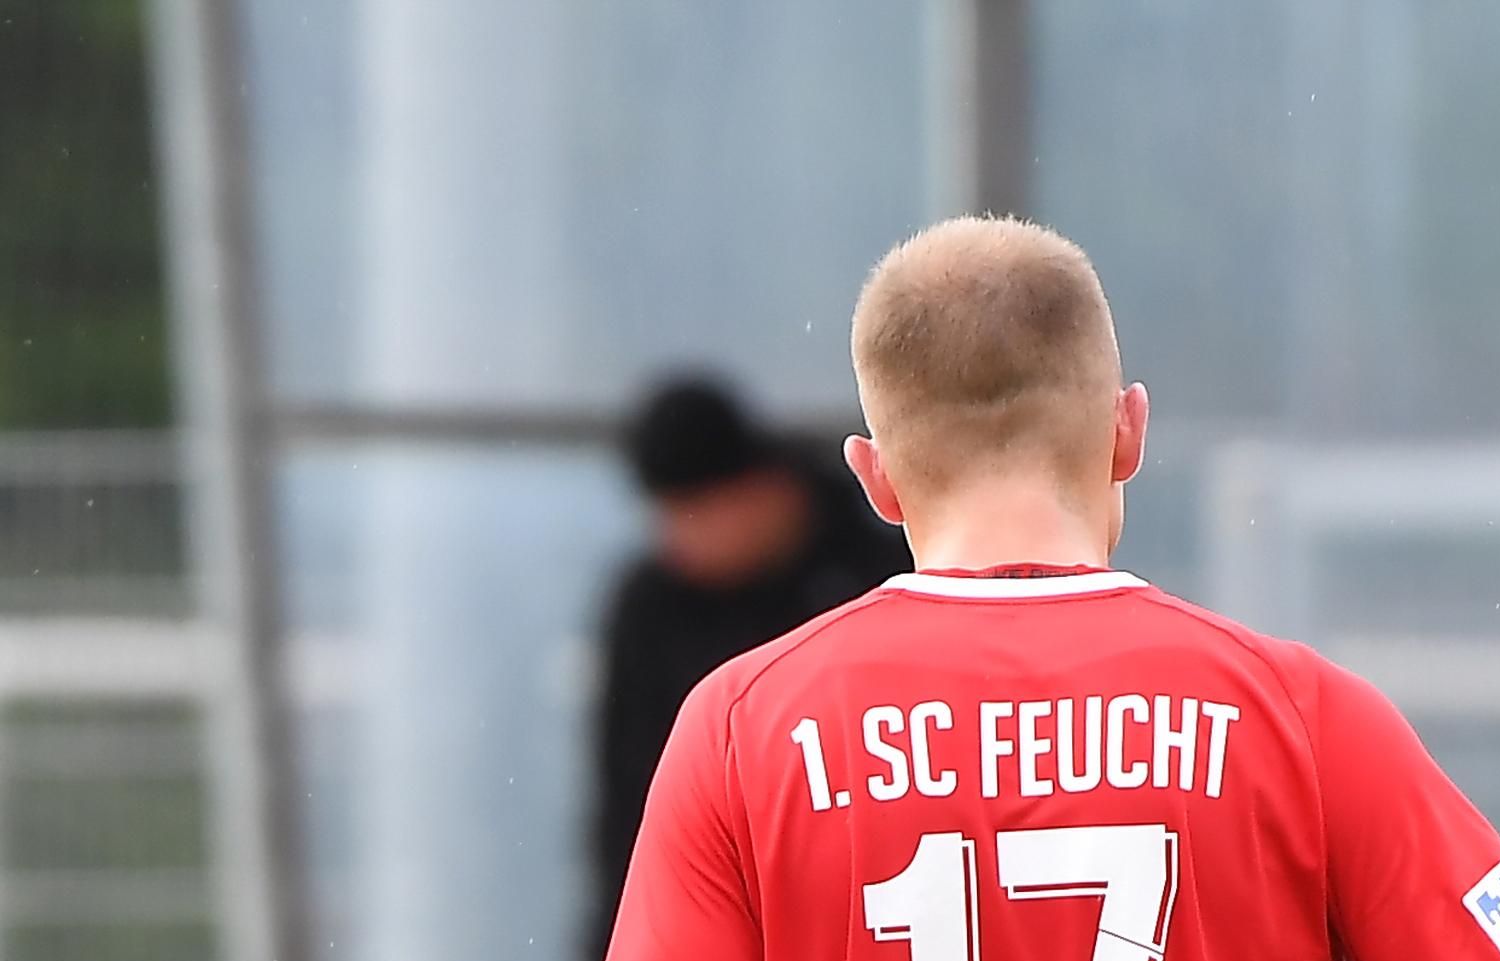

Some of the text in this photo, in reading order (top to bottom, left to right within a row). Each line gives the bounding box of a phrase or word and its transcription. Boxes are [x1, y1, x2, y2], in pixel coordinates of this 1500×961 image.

[790, 693, 1241, 812] 1. SC FEUCHT
